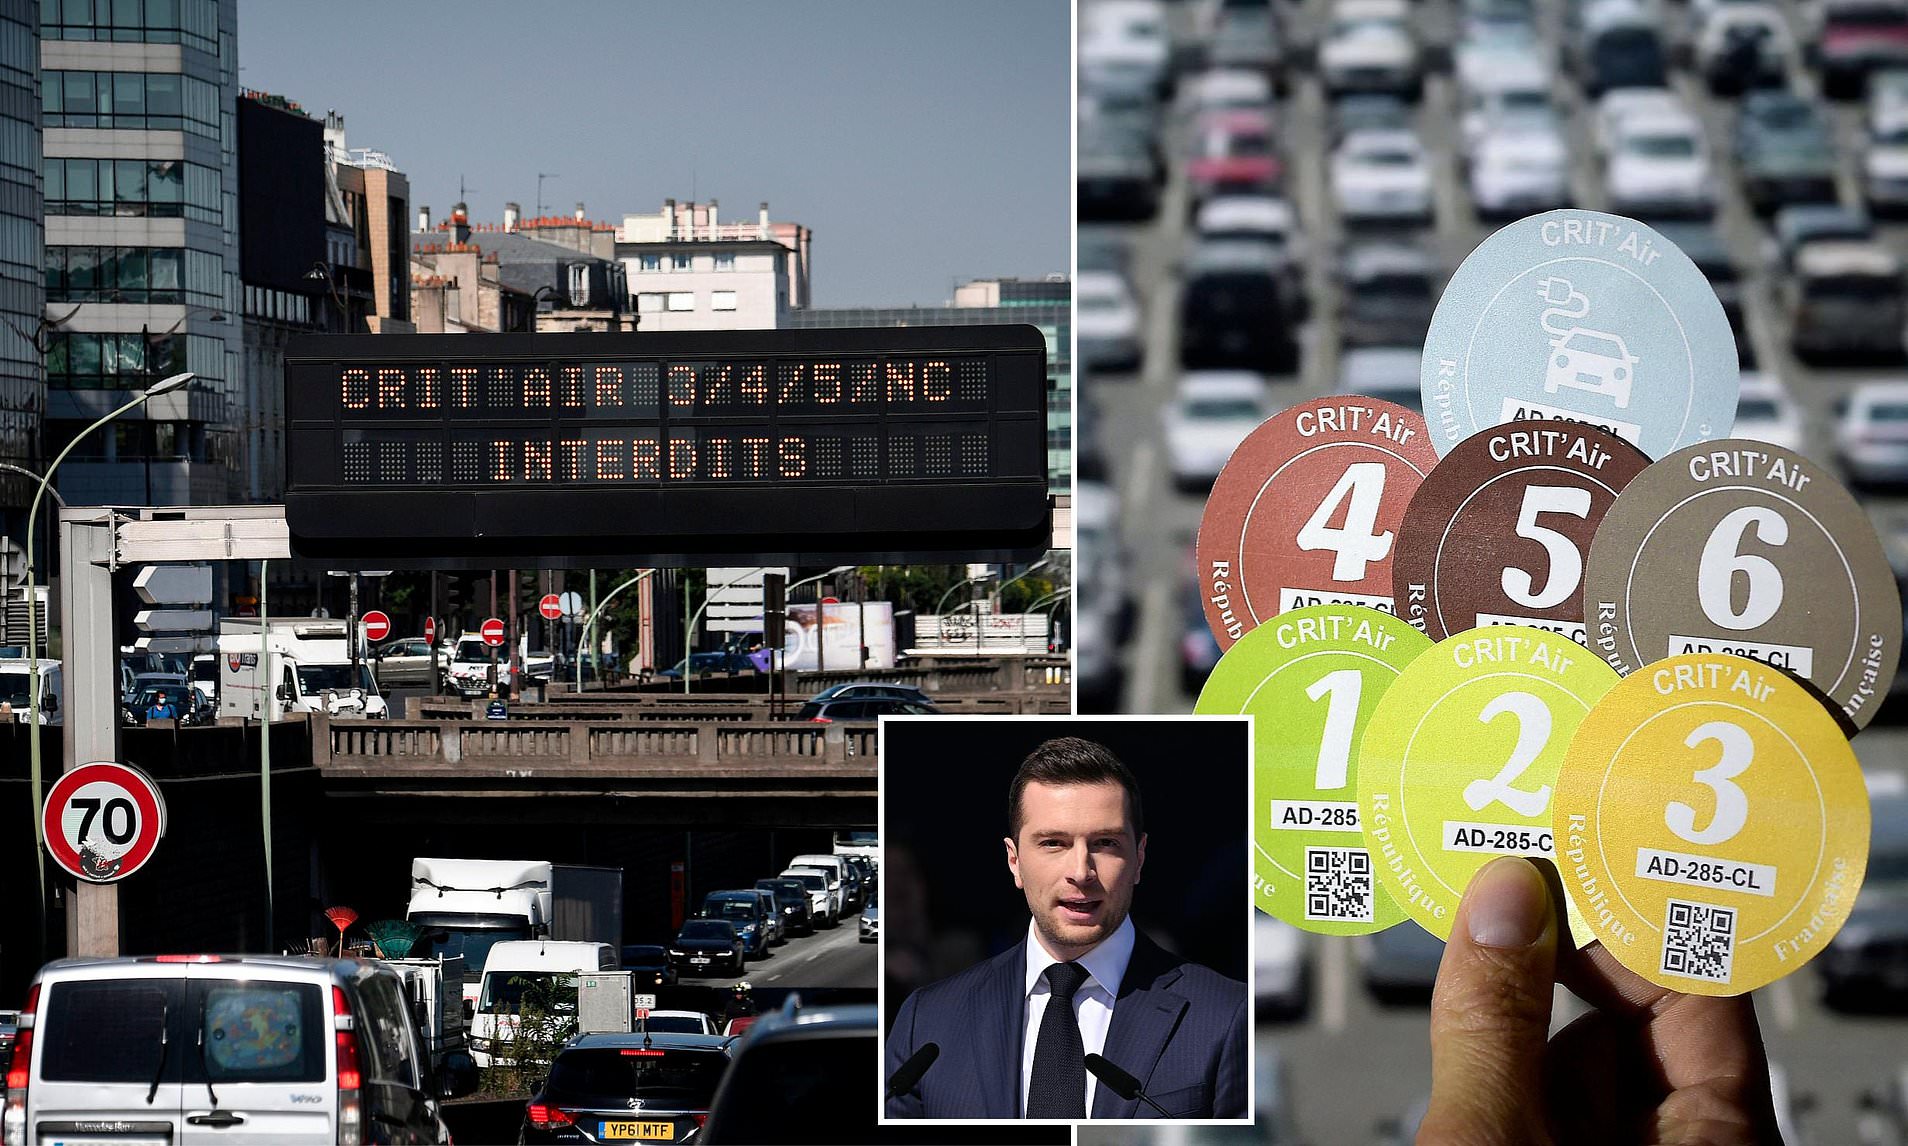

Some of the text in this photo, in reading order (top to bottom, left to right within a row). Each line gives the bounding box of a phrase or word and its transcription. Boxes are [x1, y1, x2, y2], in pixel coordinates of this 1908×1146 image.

[1541, 219, 1661, 265] CRIT'Air
[341, 360, 951, 409] CRIT'AIR 3/4/5/NC
[1296, 406, 1416, 445] CRIT'Air
[492, 437, 808, 481] INTERDITS
[1489, 430, 1612, 470] CRIT'Air
[1689, 450, 1811, 492] CRIT'Air
[1296, 462, 1394, 582] 4
[1501, 484, 1592, 609] 5
[1698, 506, 1789, 631] 6
[1276, 614, 1397, 652] CRIT'Air
[1453, 636, 1575, 676] CRIT'Air
[1653, 663, 1776, 704] CRIT'Air
[1305, 669, 1362, 790] 1
[1463, 691, 1553, 818] 2
[1664, 721, 1755, 846] 3
[71, 797, 136, 845] 70
[1371, 793, 1448, 920] République
[1647, 855, 1760, 890] AD-285-CL
[1566, 814, 1849, 962] République Française
[611, 1123, 669, 1138] YP61 MTF
